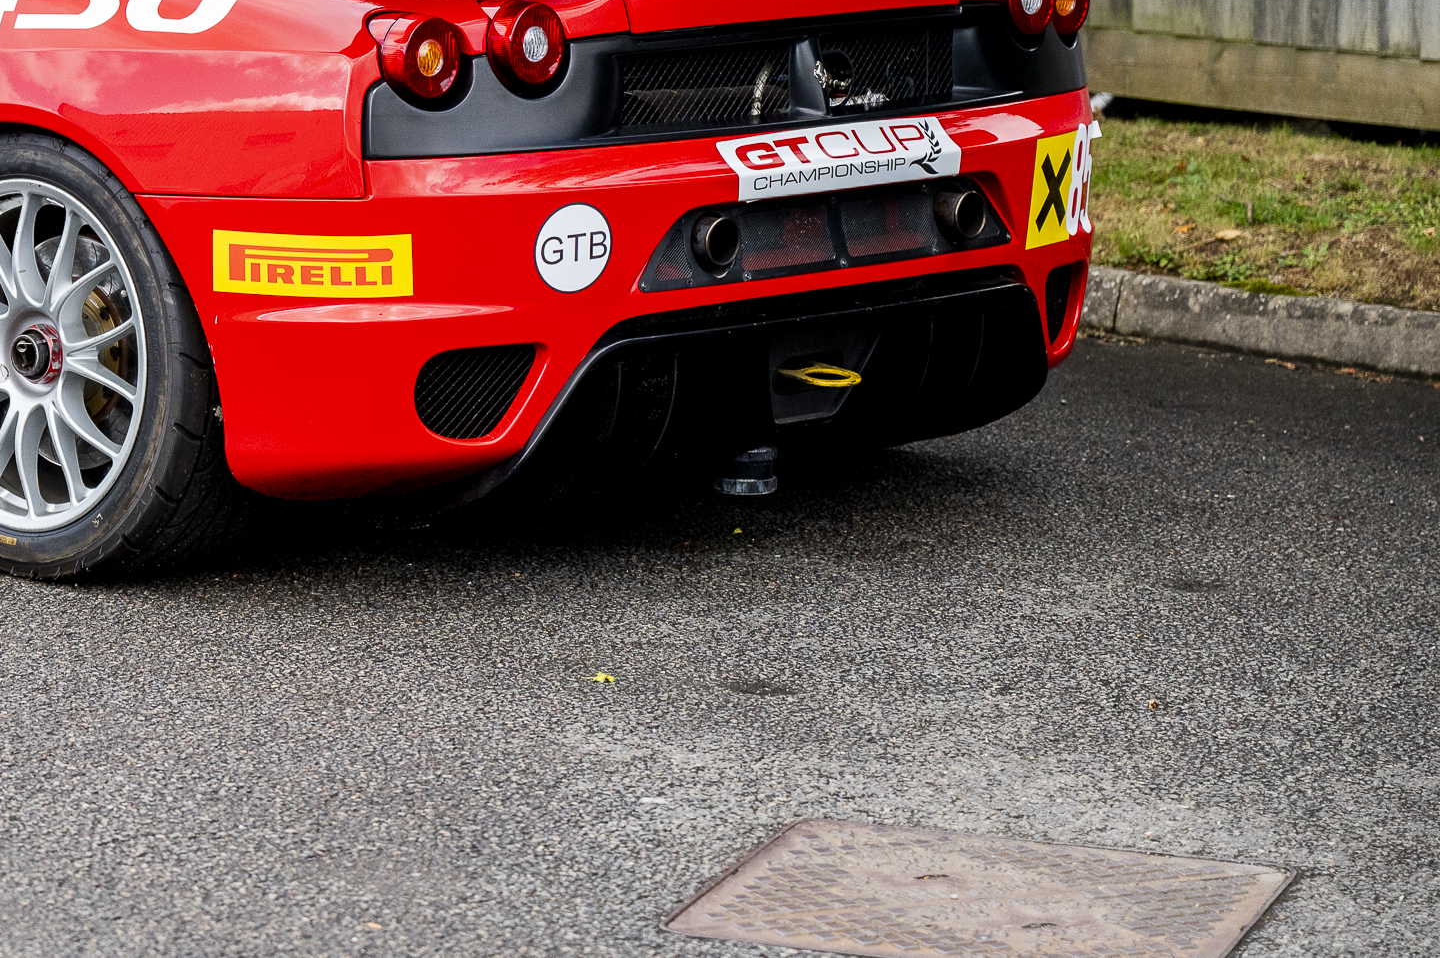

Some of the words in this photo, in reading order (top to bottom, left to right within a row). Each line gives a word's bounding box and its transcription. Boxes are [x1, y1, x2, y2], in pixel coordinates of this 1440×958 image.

[753, 157, 906, 191] CHAMPIONSHIP
[228, 243, 394, 286] PIRELLI
[540, 230, 608, 265] GTB
